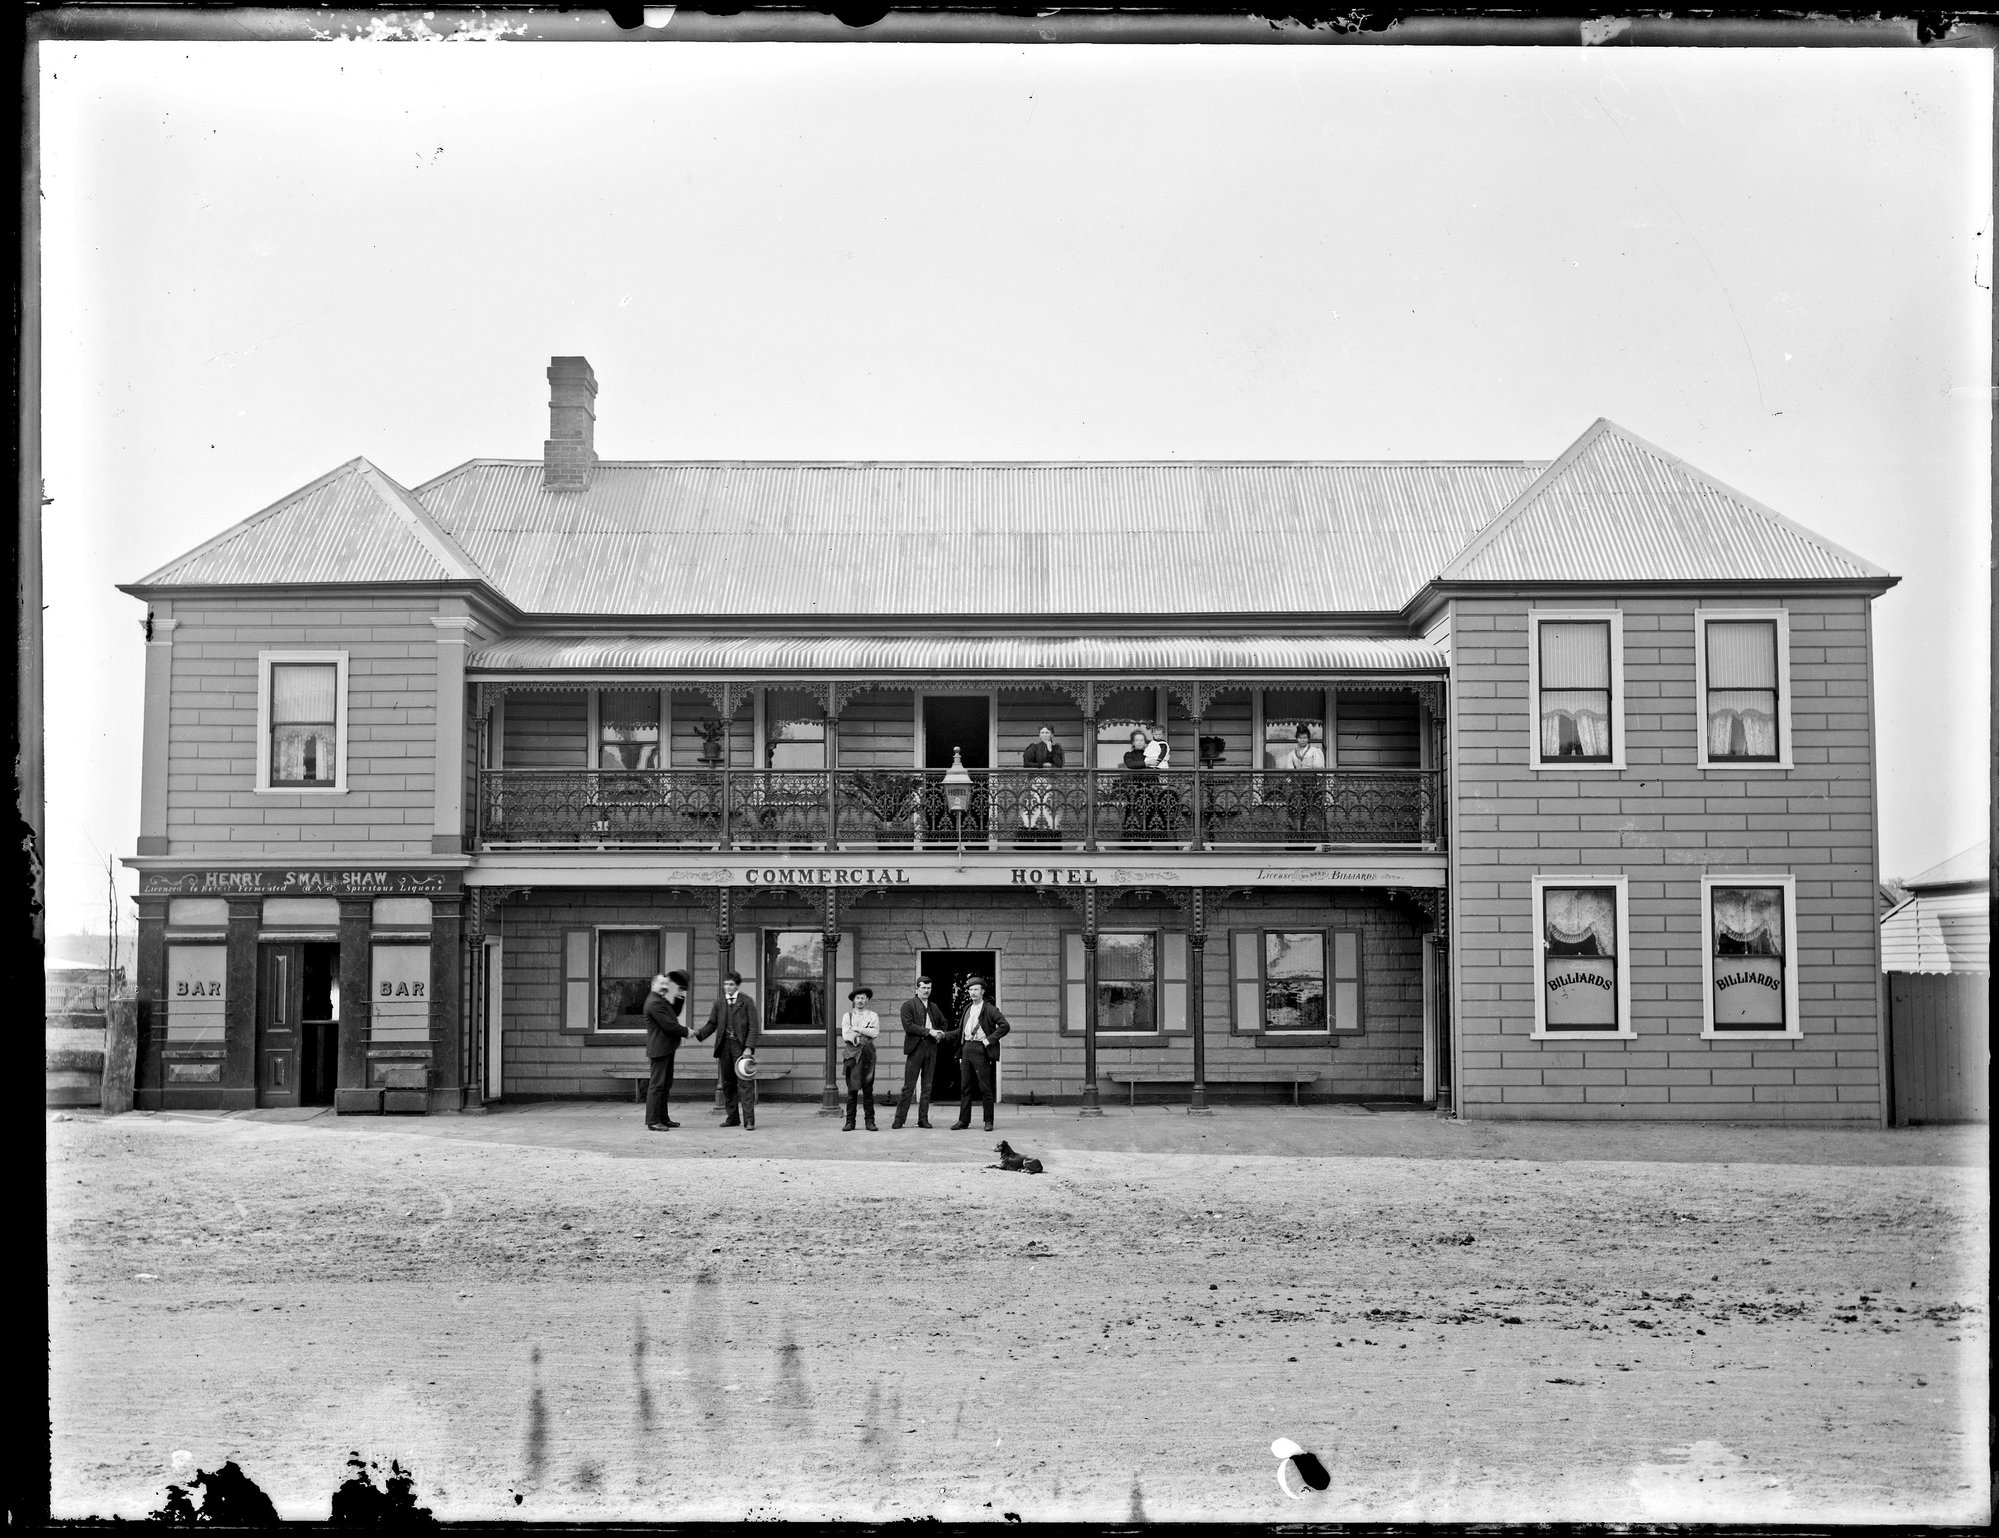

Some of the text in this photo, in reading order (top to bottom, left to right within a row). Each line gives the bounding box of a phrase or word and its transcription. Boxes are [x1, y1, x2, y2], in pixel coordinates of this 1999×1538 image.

[947, 788, 968, 796] HOTEL
[206, 872, 262, 886] HENRY
[745, 869, 1098, 885] COMMERCIAL HOTEL
[400, 885, 442, 894] Liquors
[176, 980, 221, 997] BAR
[380, 980, 425, 997] BAR
[1548, 972, 1613, 992] BILLIARDS
[1716, 972, 1781, 991] BILLIARDS
